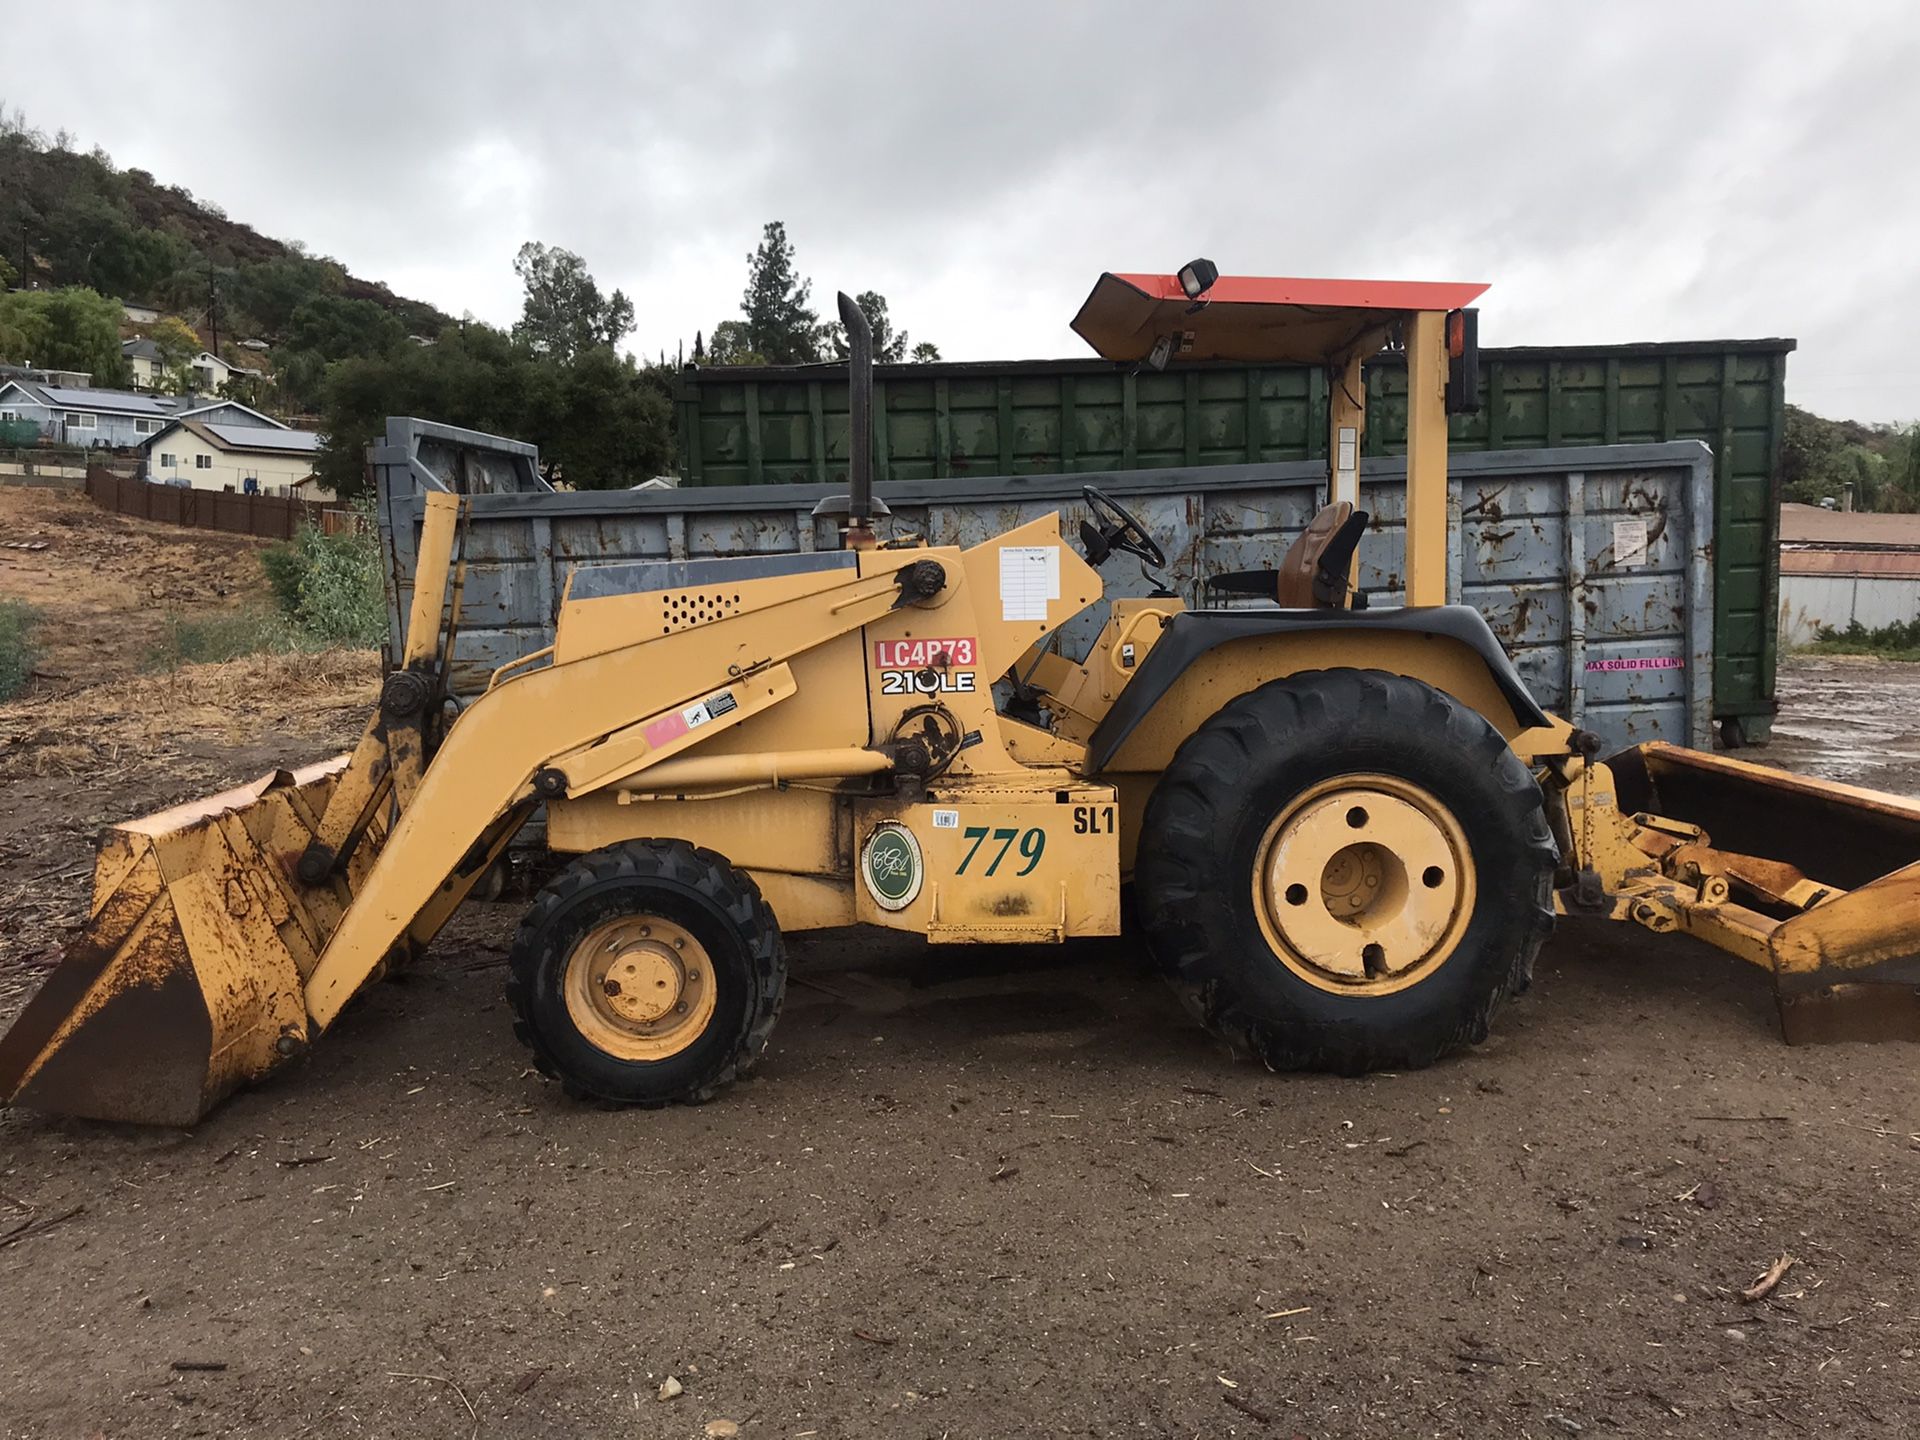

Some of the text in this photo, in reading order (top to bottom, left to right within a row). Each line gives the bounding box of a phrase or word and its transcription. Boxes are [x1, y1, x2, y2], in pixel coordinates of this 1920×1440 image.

[880, 639, 972, 667] LC4P73
[1607, 660, 1637, 670] SOLID
[1640, 659, 1660, 668] FILL
[1074, 806, 1114, 834] SL1
[955, 827, 1046, 877] 779
